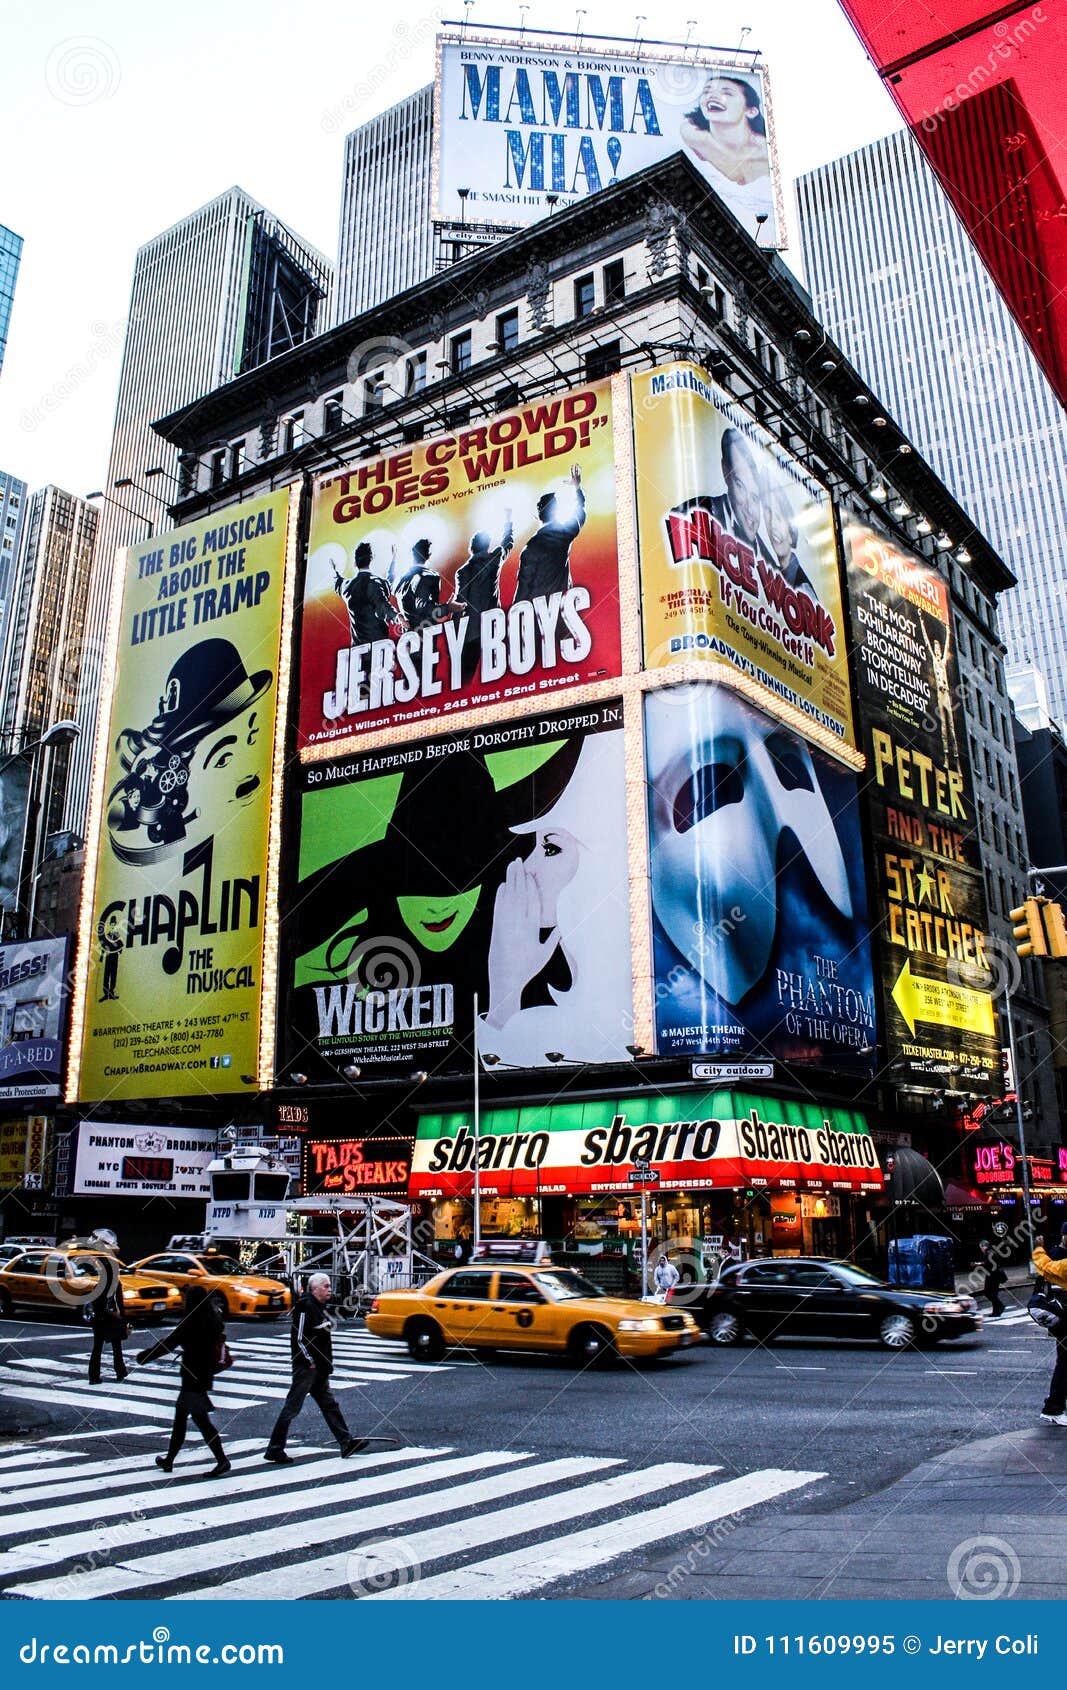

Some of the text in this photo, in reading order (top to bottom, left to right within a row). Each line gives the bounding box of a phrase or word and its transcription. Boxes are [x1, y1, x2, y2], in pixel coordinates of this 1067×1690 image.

[461, 52, 494, 60] BENNY
[498, 54, 559, 68] ANDERSSON
[564, 61, 573, 69] &
[459, 64, 663, 136] MAMMA
[483, 192, 541, 205] SMASH HIT
[651, 371, 711, 403] Matthew
[425, 391, 598, 465] CROWD
[332, 466, 450, 525] GOES
[428, 478, 506, 507] New York Times
[138, 508, 275, 579] THE BIG MUSICAL
[158, 548, 246, 601] ABOUT THE
[664, 509, 836, 657] NICE WORK
[131, 570, 270, 646] LITTLE TRAMP
[667, 588, 712, 601] IMPRIAL
[720, 575, 815, 667] If You Can Get It
[856, 605, 926, 661] EXHILARATING
[889, 609, 917, 636] MOST
[322, 586, 592, 720] JERSEY BOYS
[725, 614, 813, 686] The Tony-Winning Musical
[866, 630, 922, 675] BROADWAY
[670, 633, 756, 678] BROADWAY'S
[757, 665, 798, 705] FUNNIEST
[799, 694, 821, 721] LOVE
[822, 712, 845, 737] STORY
[861, 646, 930, 698] STORYTELLING
[867, 667, 879, 689] IN
[315, 672, 580, 741] August Wilson Theatre, 245 West 52nd Street
[872, 727, 968, 821] PETER
[887, 806, 967, 864] AND THE
[98, 843, 260, 975] CHAPLIN
[888, 902, 991, 970] CATCHER
[188, 948, 214, 971] THE
[813, 955, 839, 980] THE
[186, 965, 255, 994] MUSICAL
[776, 967, 874, 1028] PHANTOM
[113, 1037, 128, 1048] (212)
[170, 1031, 189, 1043] (800)
[191, 1028, 224, 1040] 432-7780
[143, 1020, 173, 1032] THEATRE
[184, 1018, 198, 1027] 243
[200, 1016, 221, 1026] WEST
[358, 1035, 378, 1043] STORY
[402, 1030, 432, 1038] WITCHES
[669, 1025, 745, 1037] MAJESTIC THEATRE
[786, 1012, 869, 1049] OF THE OPERA
[133, 1044, 201, 1058] TELECHARGE.COM
[402, 1042, 416, 1050] WEST
[671, 1039, 684, 1047] 247
[723, 1037, 740, 1045] Street
[704, 1066, 764, 1076] city outdoor
[89, 1136, 217, 1152] PHANTOM BROADWAY
[428, 1116, 721, 1172] sbarro sbarro
[741, 1109, 876, 1168] sbarro sbarro
[98, 1162, 119, 1171] NYC
[188, 1167, 203, 1175] NY
[975, 1141, 1015, 1170] JOE'S
[344, 1161, 407, 1191] STEAKS
[536, 1184, 567, 1193] SALAD
[591, 1182, 634, 1191] ENTREES
[660, 1179, 713, 1188] ESPRESSO
[751, 1177, 767, 1186] PIZZA
[779, 1179, 796, 1187] PASTA
[807, 1180, 822, 1188] SALAD
[212, 1207, 276, 1219] NYPD NYPD
